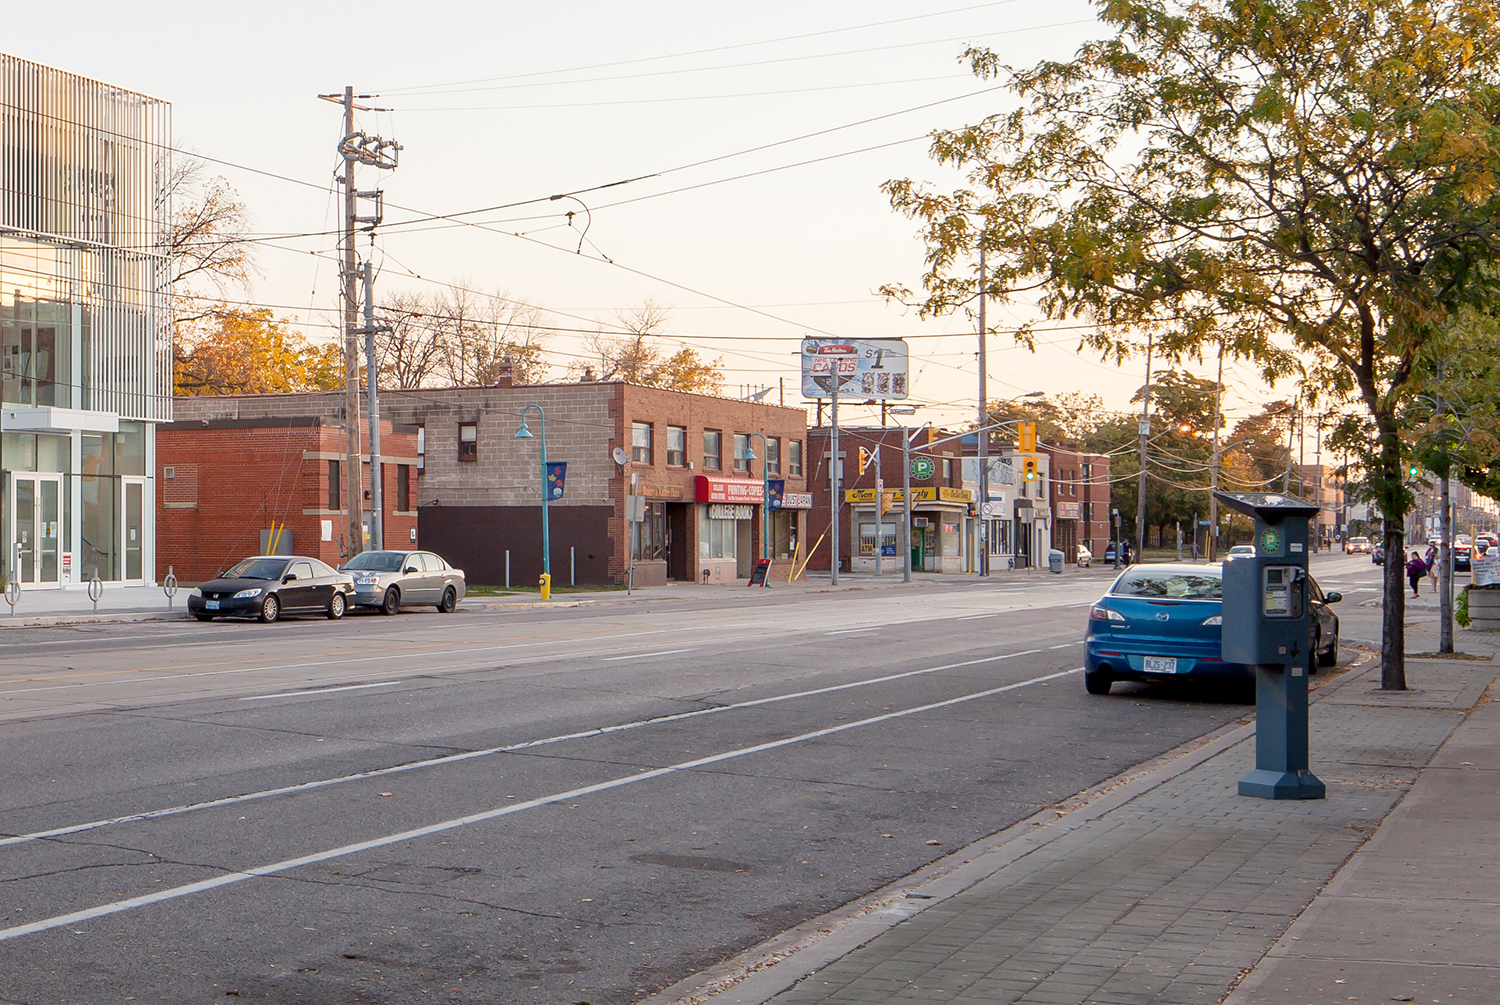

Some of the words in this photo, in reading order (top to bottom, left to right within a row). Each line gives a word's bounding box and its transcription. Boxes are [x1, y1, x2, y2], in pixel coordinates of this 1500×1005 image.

[812, 363, 856, 372] CADS
[711, 504, 735, 519] COLLEGE
[735, 505, 754, 520] BOOKS
